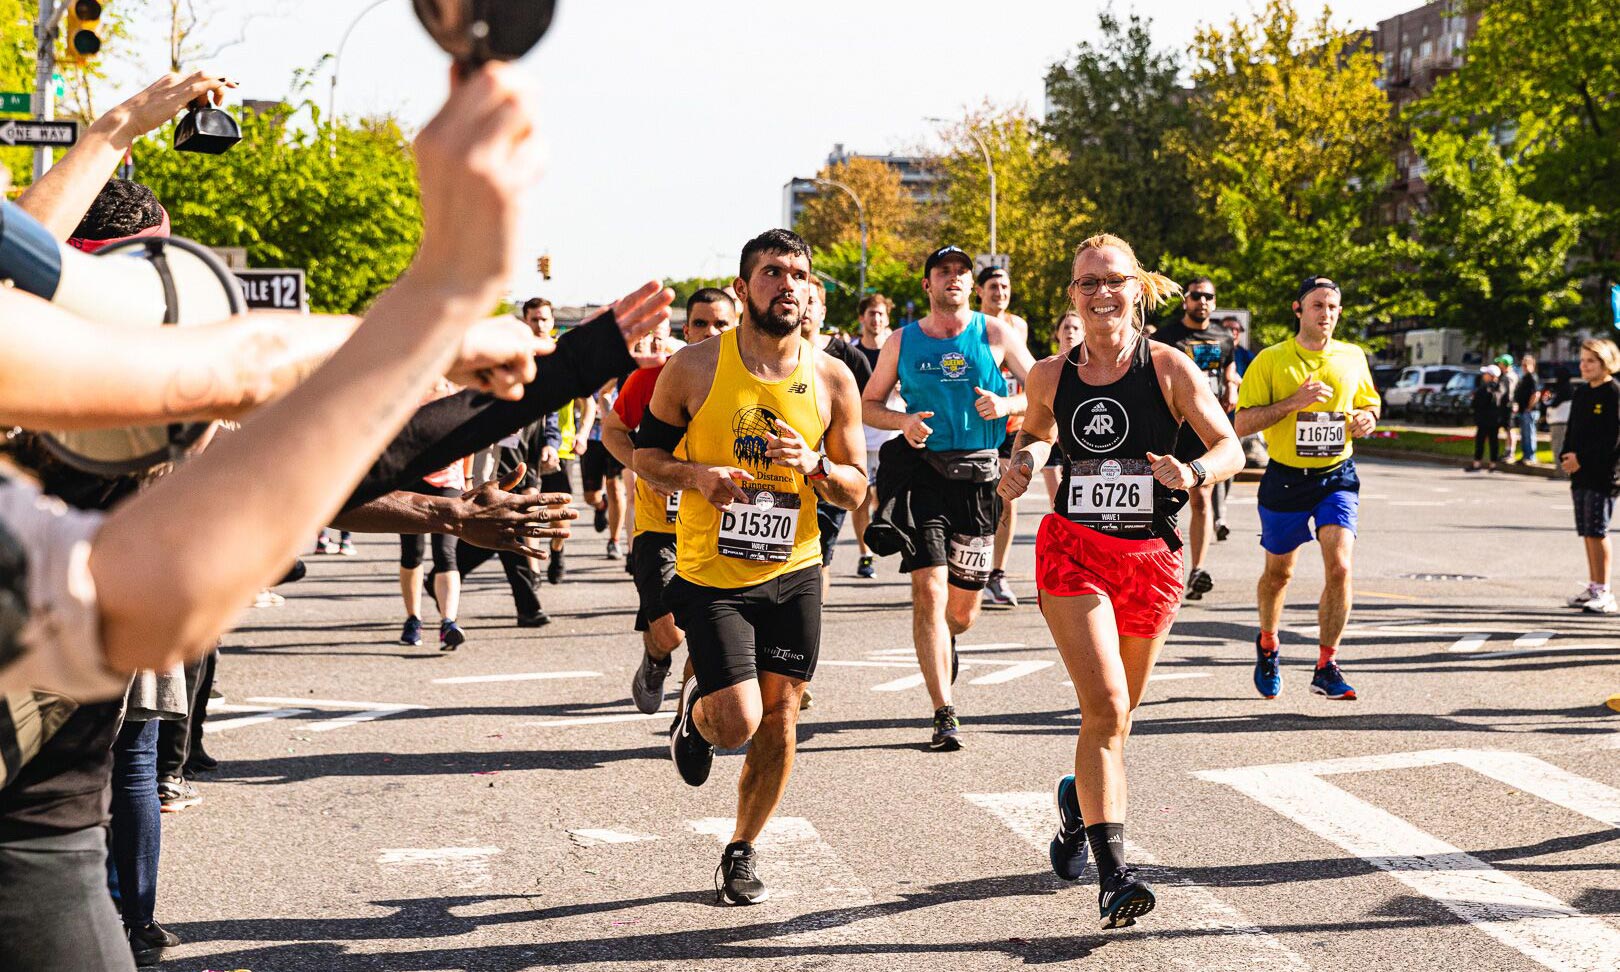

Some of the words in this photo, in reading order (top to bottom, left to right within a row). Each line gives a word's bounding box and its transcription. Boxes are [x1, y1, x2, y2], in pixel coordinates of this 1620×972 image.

[7, 129, 32, 139] ONE
[40, 130, 65, 139] WAY
[270, 275, 297, 307] 12
[1083, 414, 1115, 435] AR
[1308, 426, 1343, 442] 16750
[757, 471, 794, 484] Distance
[741, 480, 776, 491] Runners
[670, 491, 679, 506] E
[1071, 486, 1083, 506] F
[1092, 483, 1140, 507] 6726
[1101, 513, 1117, 521] WAVE
[721, 511, 737, 532] D
[738, 511, 792, 540] 15370
[751, 542, 765, 550] WAVE
